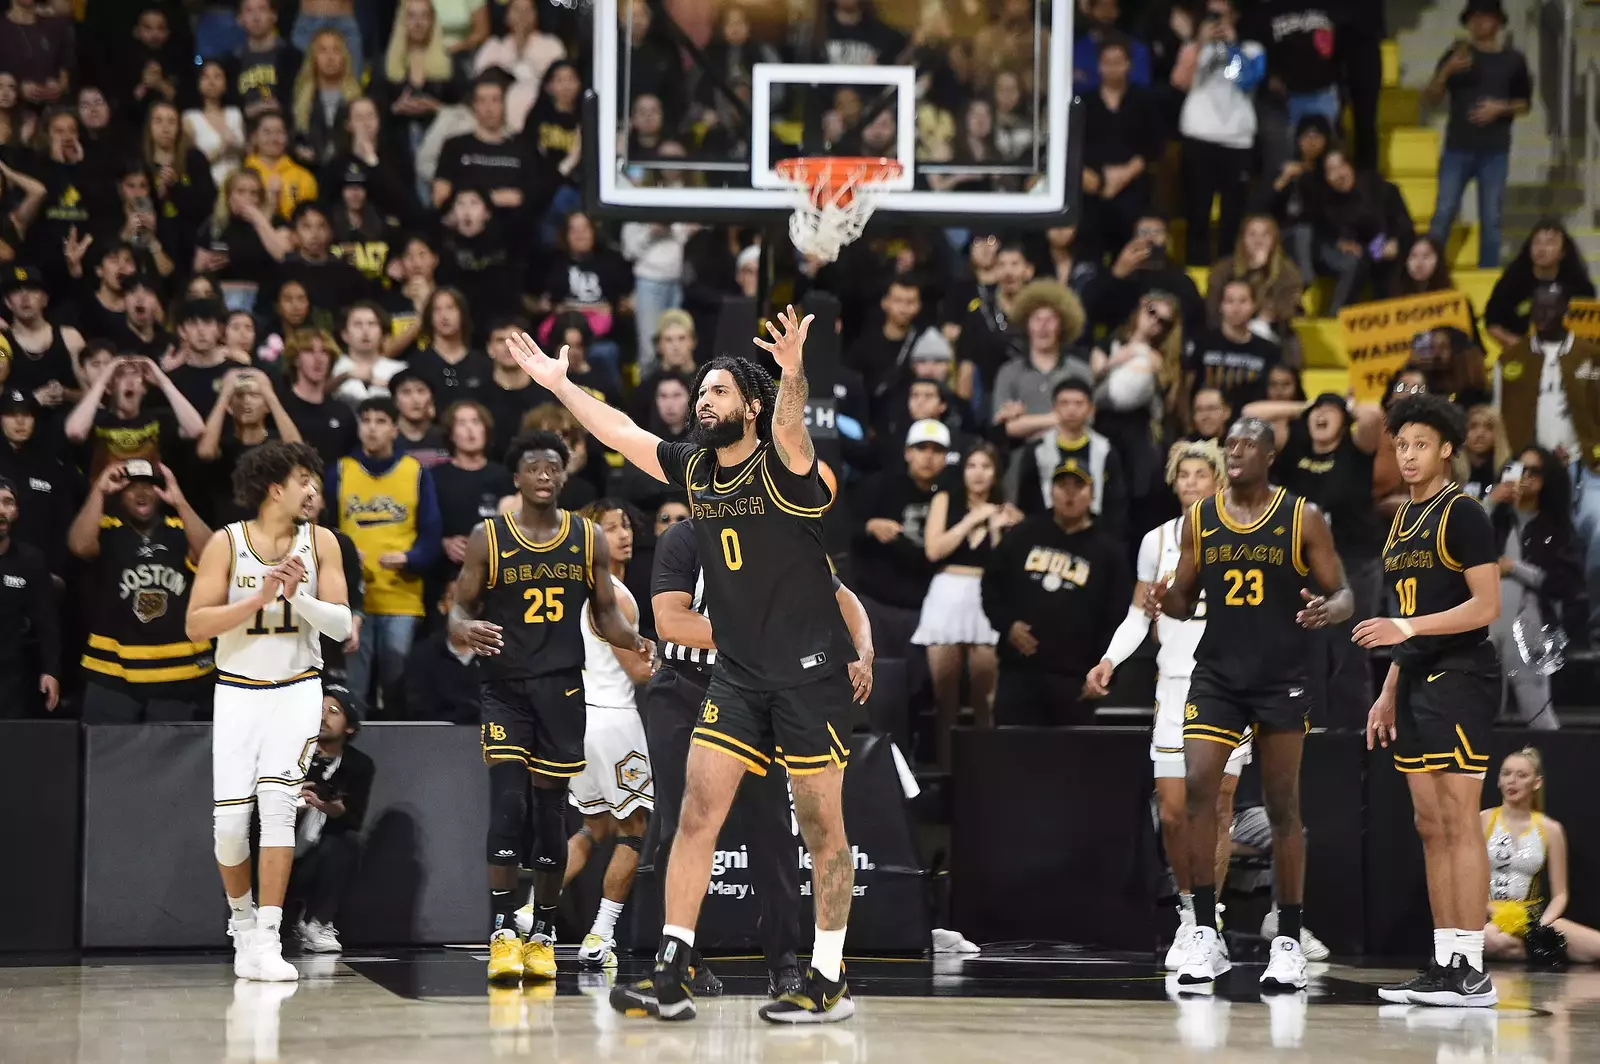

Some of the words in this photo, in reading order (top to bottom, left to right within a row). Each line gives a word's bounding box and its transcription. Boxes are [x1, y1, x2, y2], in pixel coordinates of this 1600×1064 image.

[1346, 313, 1389, 331] YOU
[1395, 300, 1461, 324] DON'T
[1348, 341, 1412, 361] WANN
[693, 496, 765, 520] BEACH
[720, 528, 743, 571] 0
[1205, 544, 1284, 566] BEACH
[1384, 549, 1434, 573] BEACH
[236, 575, 256, 588] UC
[503, 562, 583, 585] BEACH
[1223, 568, 1264, 606] 23
[523, 586, 565, 624] 25
[1395, 576, 1417, 616] 10
[246, 593, 300, 636] 11
